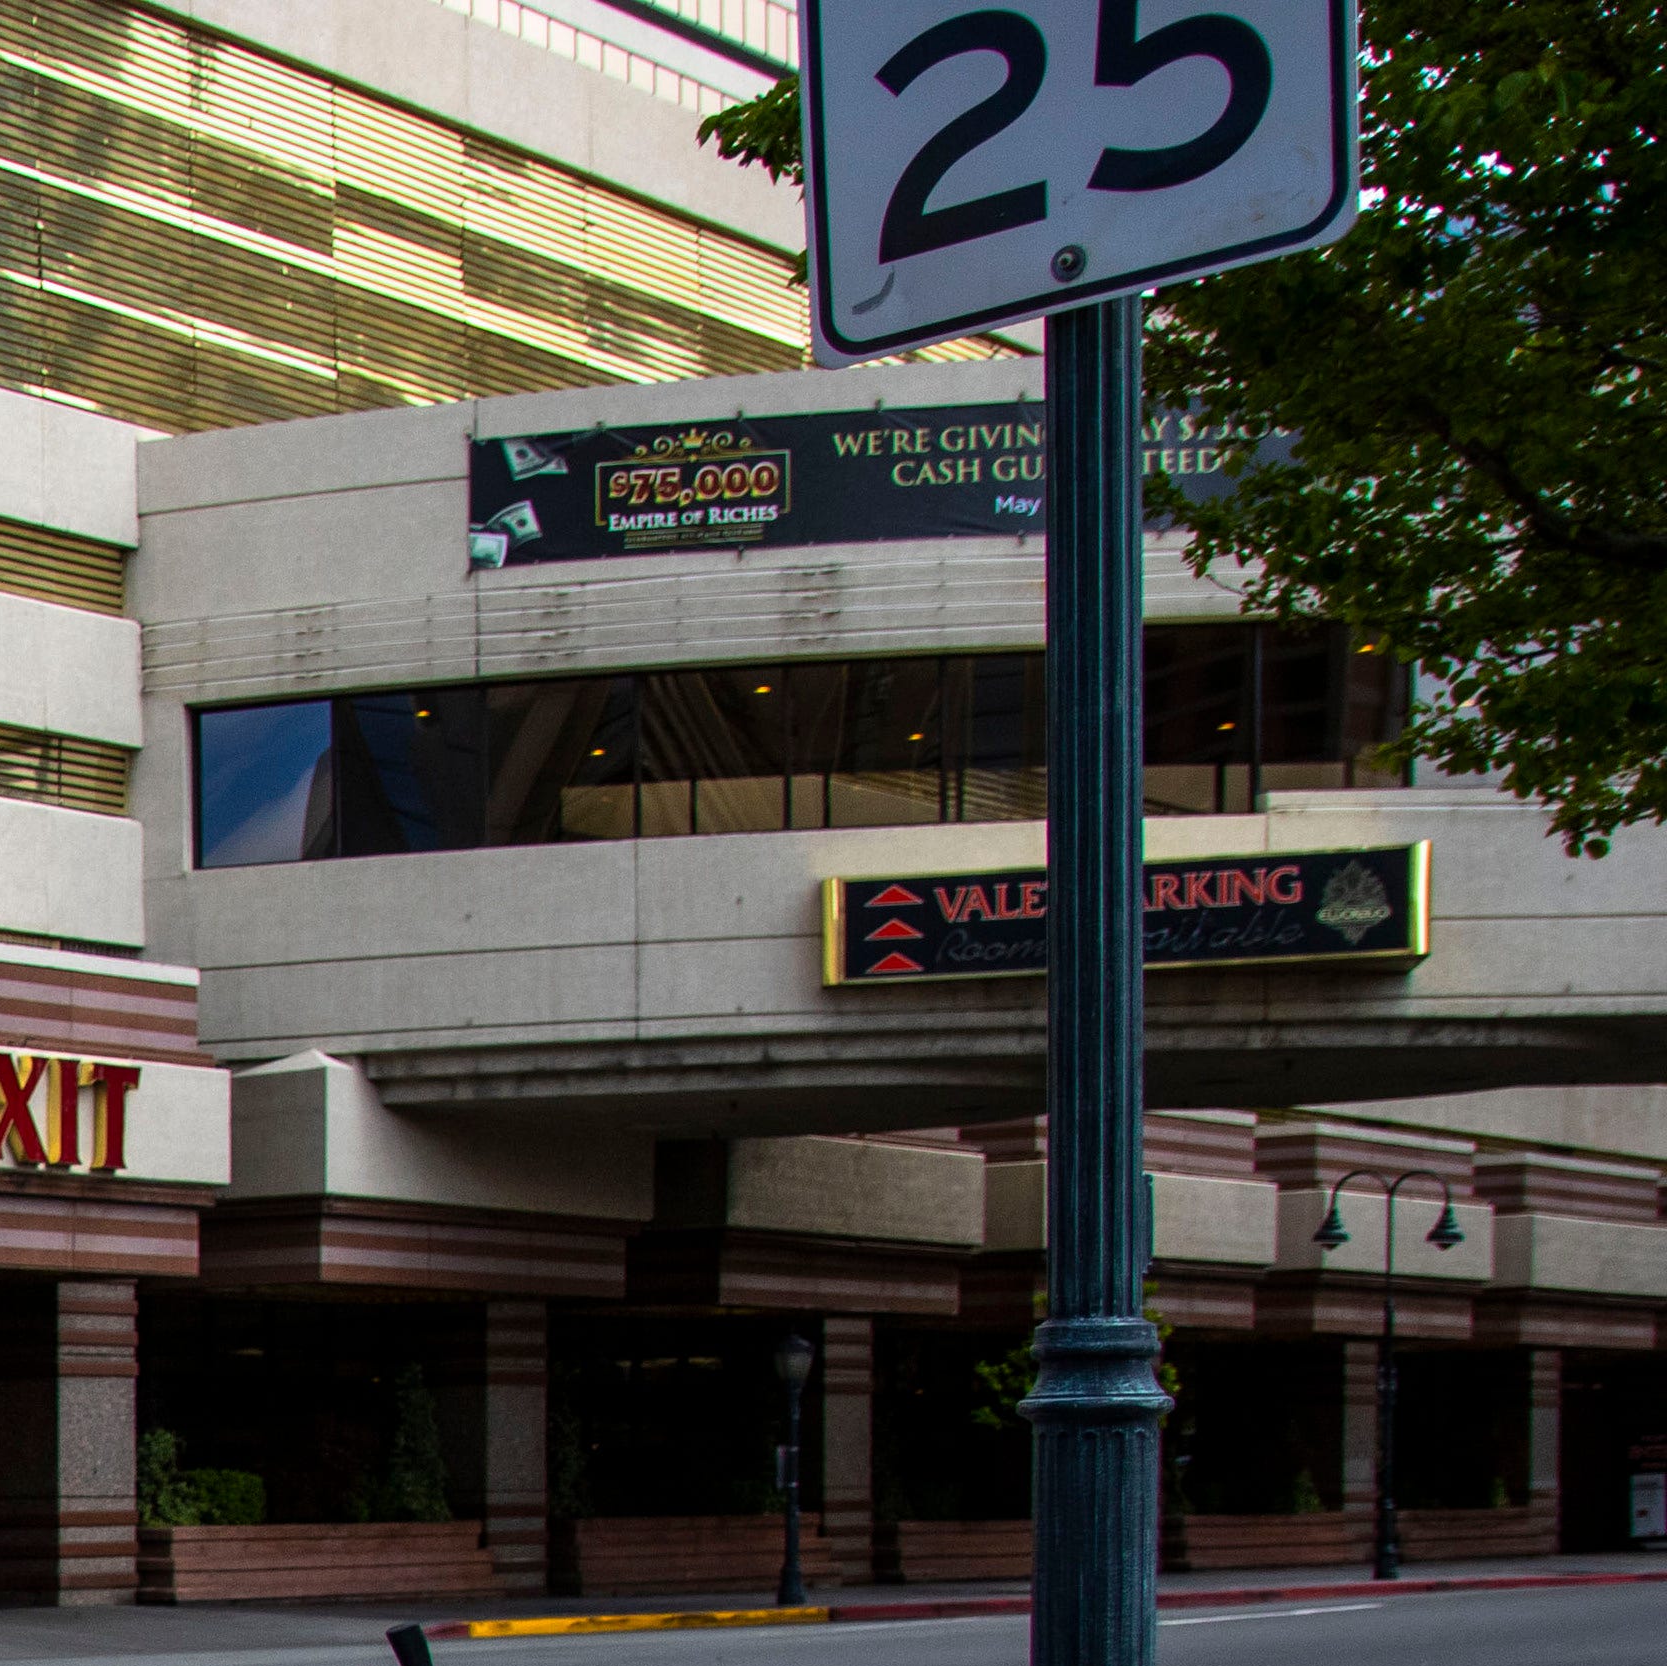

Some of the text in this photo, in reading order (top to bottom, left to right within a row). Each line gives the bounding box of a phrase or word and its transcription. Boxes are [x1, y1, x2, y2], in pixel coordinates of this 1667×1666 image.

[873, 0, 1273, 264] 25
[832, 422, 1047, 457] WE'RE GIVIN
[608, 461, 780, 507] $75,000
[891, 457, 982, 487] CASH
[608, 504, 780, 532] EMPIRE OF RICHES
[995, 495, 1043, 517] May
[933, 864, 1304, 922] VALE RKING
